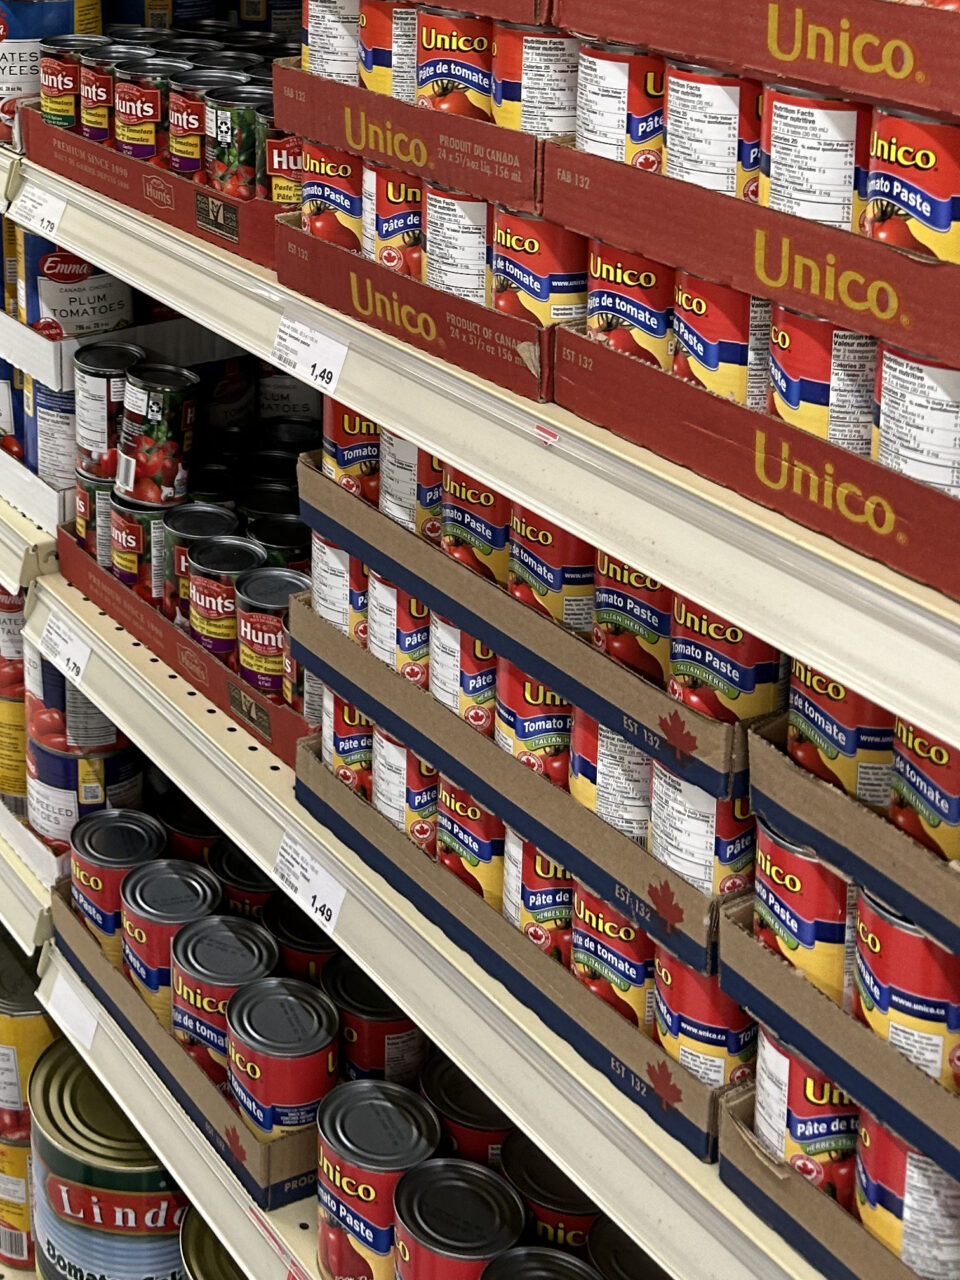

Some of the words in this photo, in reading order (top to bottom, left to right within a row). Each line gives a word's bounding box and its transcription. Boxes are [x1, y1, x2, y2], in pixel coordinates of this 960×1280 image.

[422, 28, 488, 52] Unico
[523, 37, 547, 46] Nutrition
[768, 3, 914, 79] Unico
[436, 63, 448, 73] de
[451, 63, 489, 86] tomate
[773, 102, 797, 115] Nutrition
[799, 108, 814, 117] Facts
[344, 106, 428, 168] Unico
[440, 134, 471, 154] PRODUIT
[486, 147, 520, 168] CANADA
[557, 167, 572, 183] FAB
[574, 173, 590, 190] 132
[324, 186, 351, 209] Paste
[893, 183, 931, 216] Paste
[382, 219, 403, 235] Pâte
[407, 214, 420, 225] de
[43, 258, 88, 275] Emma
[506, 261, 541, 291] tomate
[589, 256, 656, 288] Unico
[753, 228, 899, 319] Unico
[51, 301, 126, 318] TOMATOES
[69, 293, 107, 305] PLUM
[350, 271, 436, 341] Unico
[446, 313, 480, 336] PRODUCT
[616, 297, 658, 329] tomate
[678, 321, 704, 356] Paste
[562, 345, 576, 364] EST
[578, 354, 593, 371] 132
[310, 363, 333, 385] 1,49
[343, 446, 378, 460] Tomato
[754, 428, 896, 536] Unico
[464, 514, 492, 539] Paste
[520, 548, 554, 583] tomate
[626, 597, 659, 626] Paste
[674, 596, 744, 643] Unico
[405, 631, 427, 648] Pâte
[65, 656, 81, 677] 1,79
[705, 650, 740, 682] Paste
[469, 674, 492, 690] Pâte
[702, 673, 728, 693] HERBS
[524, 718, 563, 733] Tomato
[623, 715, 639, 737] EST
[641, 728, 661, 751] 132
[804, 705, 847, 746] tomate
[339, 738, 357, 751] Pâte
[532, 737, 559, 747] ITALIAN
[906, 766, 949, 813] tomate
[453, 824, 479, 852] Paste
[78, 895, 103, 924] Paste
[311, 894, 332, 922] 1,49
[529, 892, 552, 906] Pâte
[555, 891, 569, 902] de
[574, 891, 636, 941] Unico
[768, 893, 799, 932] Paste
[125, 947, 147, 979] Paste
[597, 942, 637, 978] tomate
[891, 993, 945, 1015] www.unico.ca
[182, 1014, 194, 1030] de
[680, 1021, 726, 1041] www.unico.ca
[610, 1058, 626, 1078] EST
[630, 1073, 647, 1097] 132
[797, 1120, 827, 1137] Pâte
[830, 1120, 847, 1131] de
[806, 1140, 835, 1152] HERBES
[339, 1203, 374, 1243] Paste
